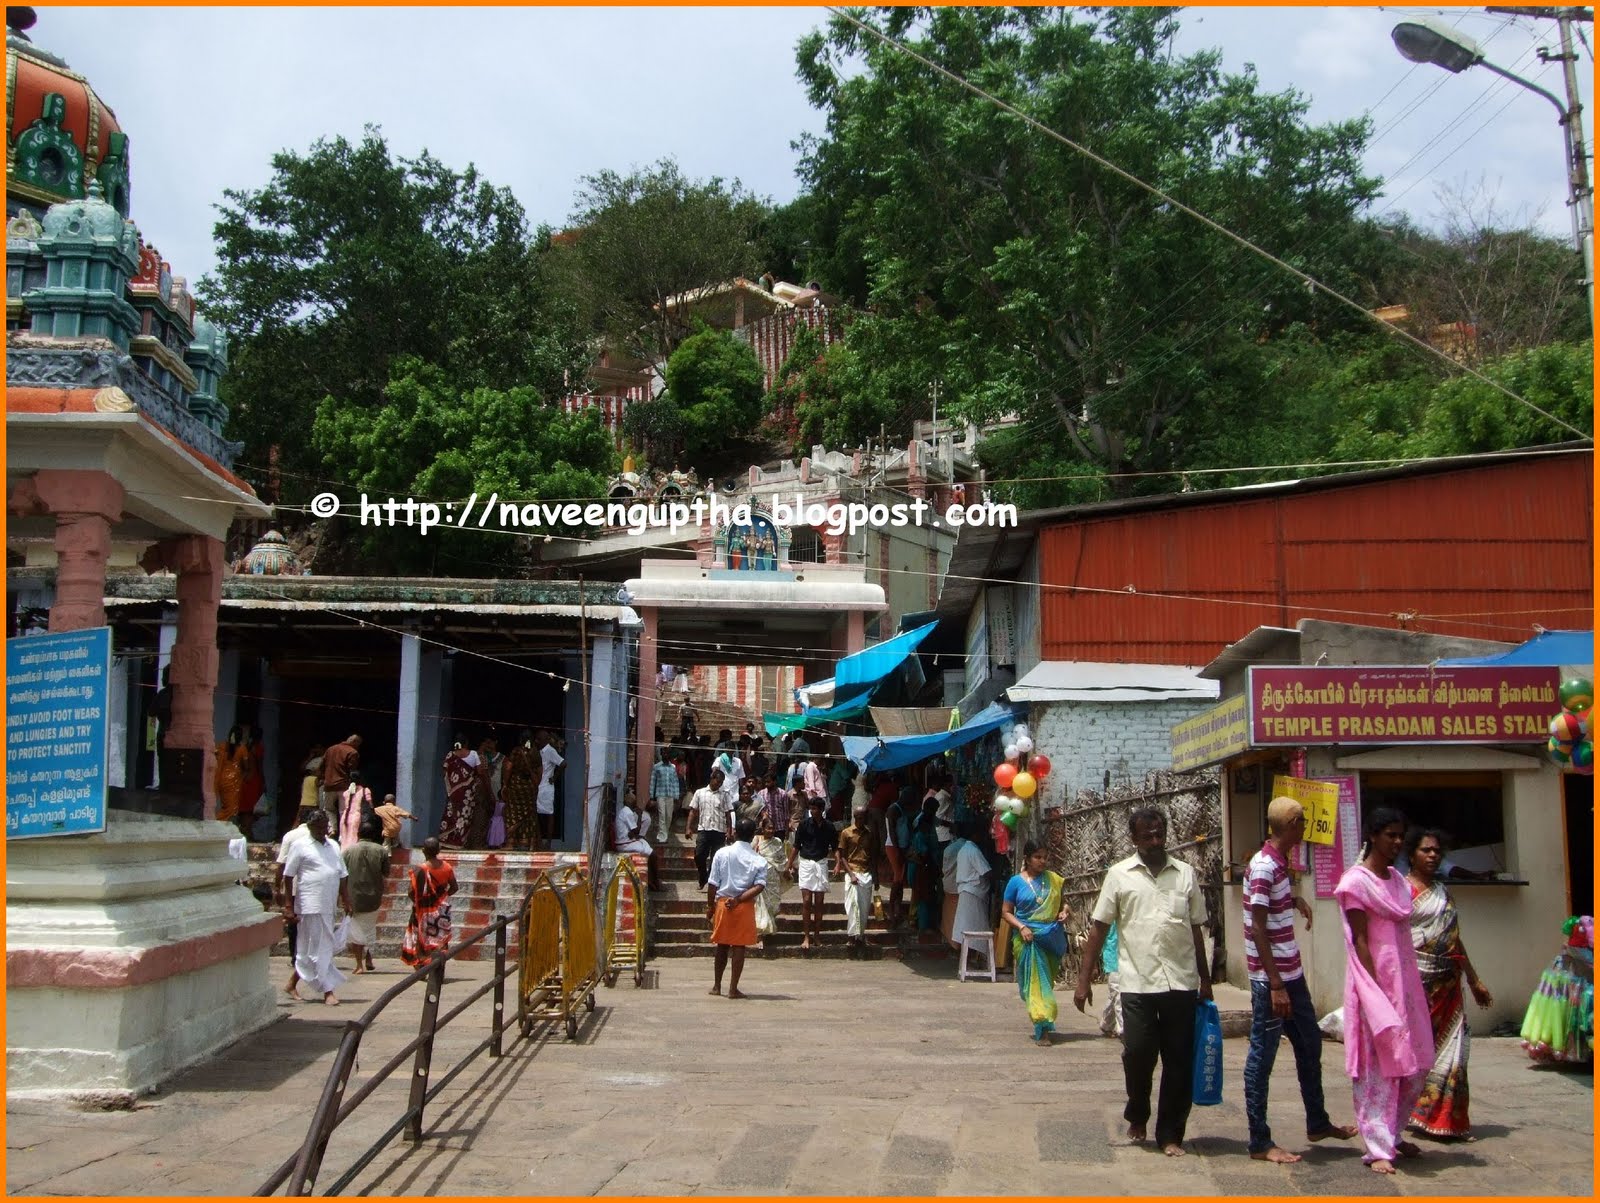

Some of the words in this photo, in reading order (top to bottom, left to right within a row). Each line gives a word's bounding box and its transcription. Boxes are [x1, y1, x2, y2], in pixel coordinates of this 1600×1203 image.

[1262, 682, 1346, 712] திருக்கோயில்
[1349, 681, 1430, 709] பிரசாதங்கள்
[1434, 681, 1494, 709] விற்பனை
[1499, 680, 1556, 709] நிலையம்
[7, 713, 28, 727] INDLY
[29, 710, 51, 724] AVOID
[52, 708, 73, 721] FOOT
[74, 706, 101, 720] WEARS
[1262, 716, 1334, 737] TEMPLE
[1338, 715, 1436, 736] PRASADAM
[1441, 715, 1498, 736] SALES
[9, 732, 24, 744] AND
[25, 727, 57, 742] LUNGIES
[58, 726, 75, 739] AND
[76, 725, 92, 737] TRY
[7, 749, 17, 761] TO
[18, 744, 52, 759] PROTECT
[53, 742, 92, 757] SANCTITY
